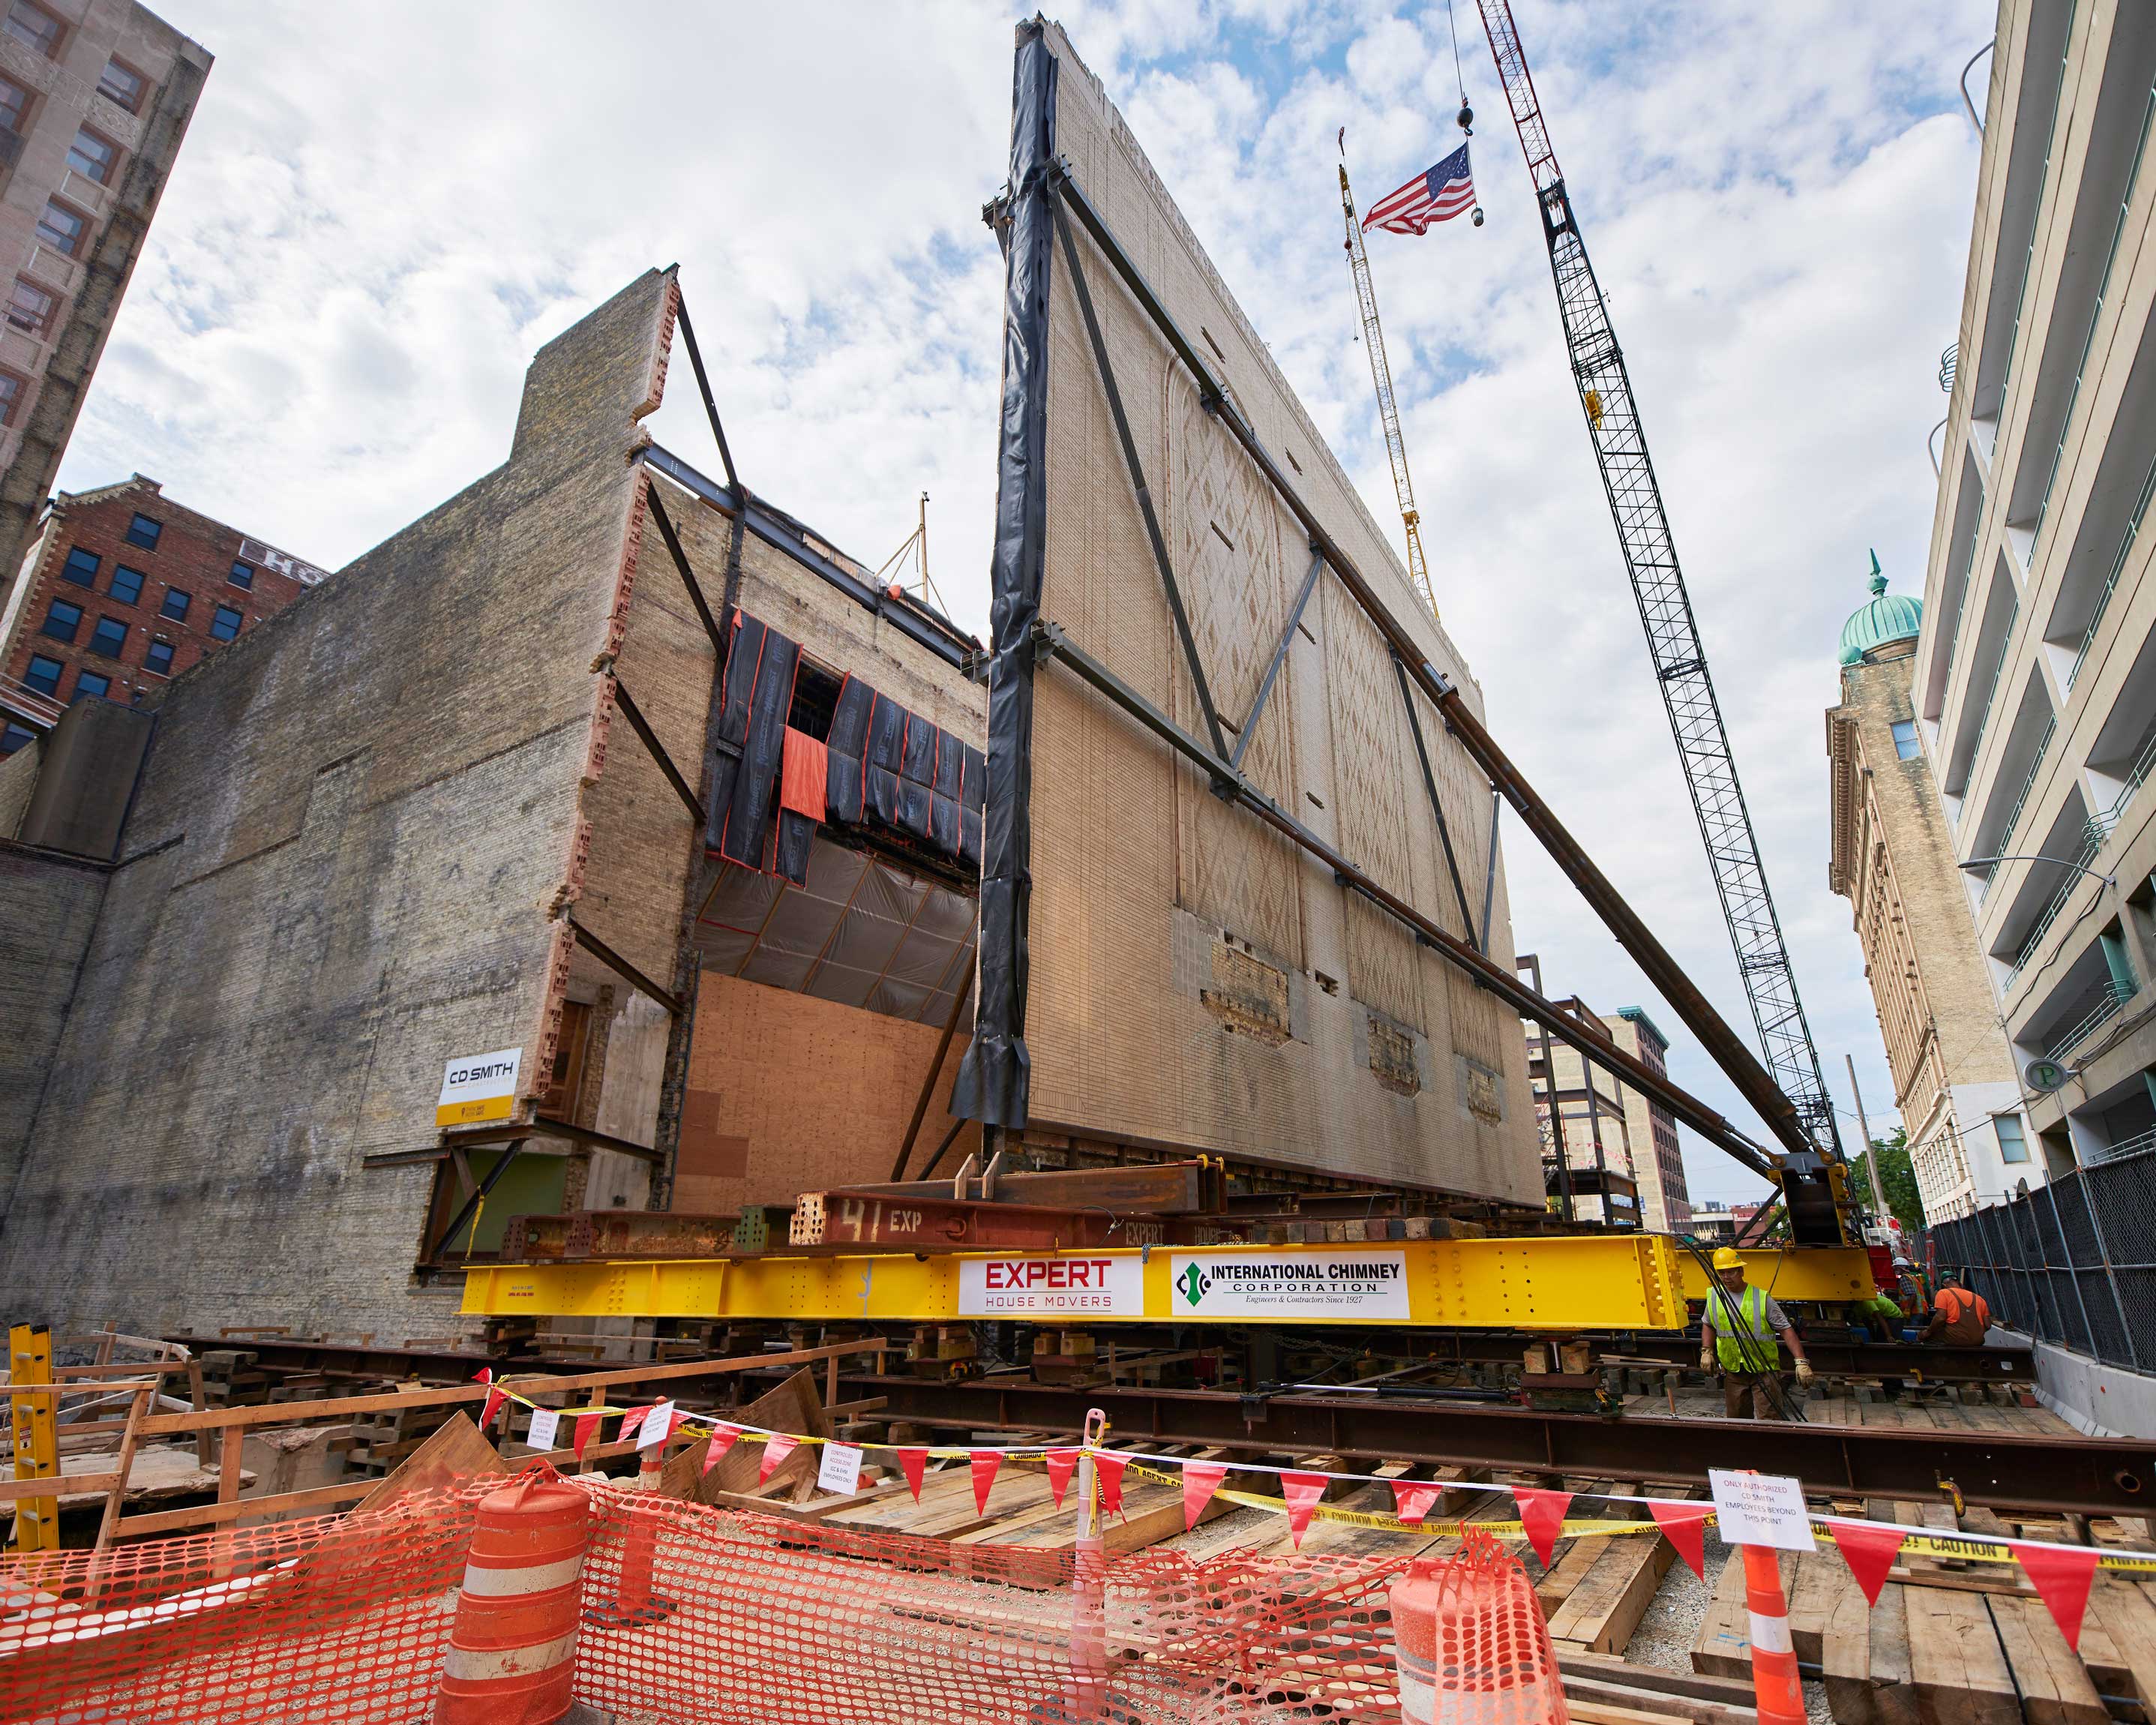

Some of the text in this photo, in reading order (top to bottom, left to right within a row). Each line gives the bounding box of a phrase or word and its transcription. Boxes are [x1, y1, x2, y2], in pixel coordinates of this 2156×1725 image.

[450, 1062, 513, 1084] CD SMITH
[2036, 1066, 2055, 1084] P
[842, 1198, 922, 1242] 41 EXP
[1126, 1222, 1164, 1246] EXPERT
[986, 1260, 1112, 1288] EXPERT
[1211, 1263, 1400, 1280] INTERNATIONAL CHIMNEY
[1233, 1283, 1377, 1292] CORPORATION
[986, 1297, 1111, 1307] HOUSE MOVERS
[1246, 1295, 1277, 1304] Engineers
[1286, 1295, 1324, 1304] Contractors
[1325, 1295, 1345, 1304] Since
[1346, 1296, 1363, 1304] 1927
[1723, 1480, 1788, 1493] ONLY AUTHORIZED
[1752, 1494, 1775, 1502] SMITH
[1725, 1501, 1797, 1516] EMPLOYEES BEYOND
[1744, 1514, 1783, 1525] THIS POINT
[1930, 1537, 1997, 1557] CAUTION
